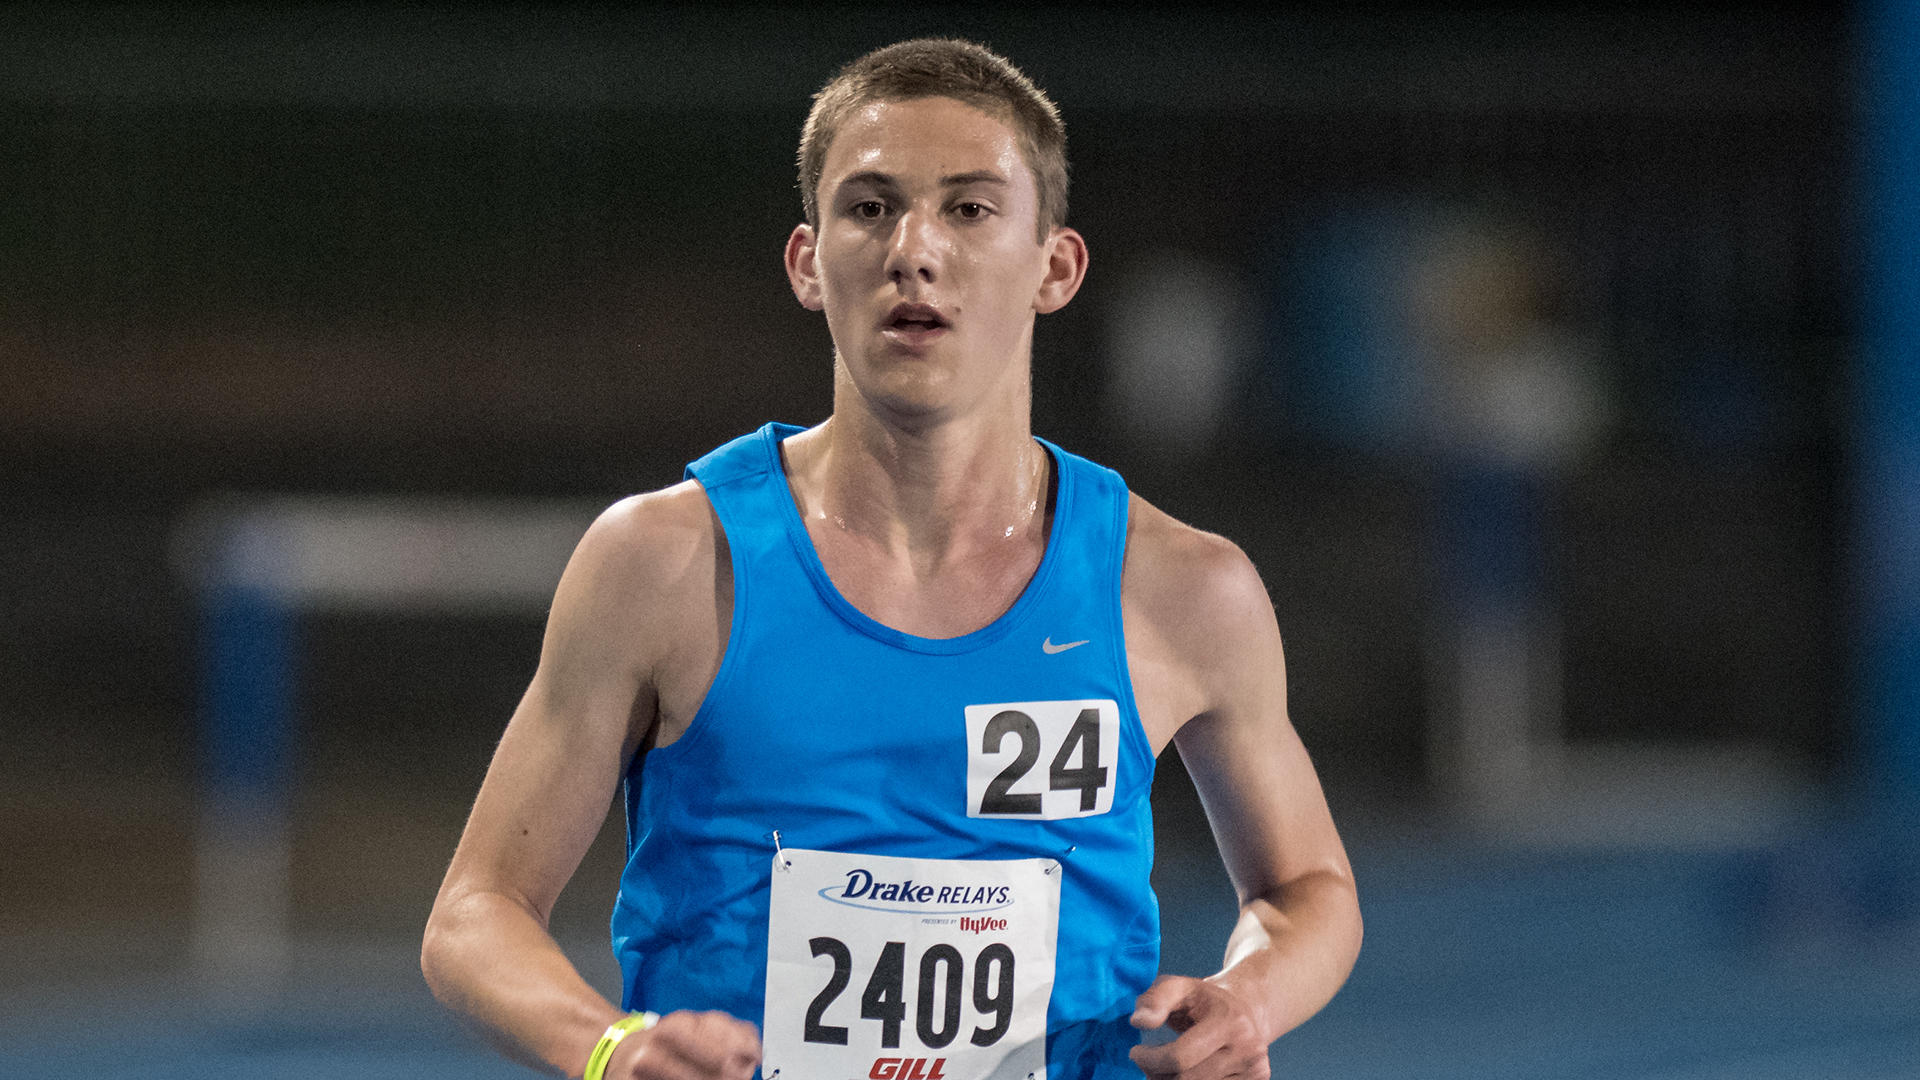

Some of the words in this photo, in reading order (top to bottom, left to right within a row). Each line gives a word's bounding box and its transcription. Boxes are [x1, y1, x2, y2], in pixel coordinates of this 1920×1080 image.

[979, 708, 1108, 815] 24
[841, 868, 934, 903] Drake
[804, 936, 1016, 1049] 2409
[868, 1057, 947, 1080] GILL
